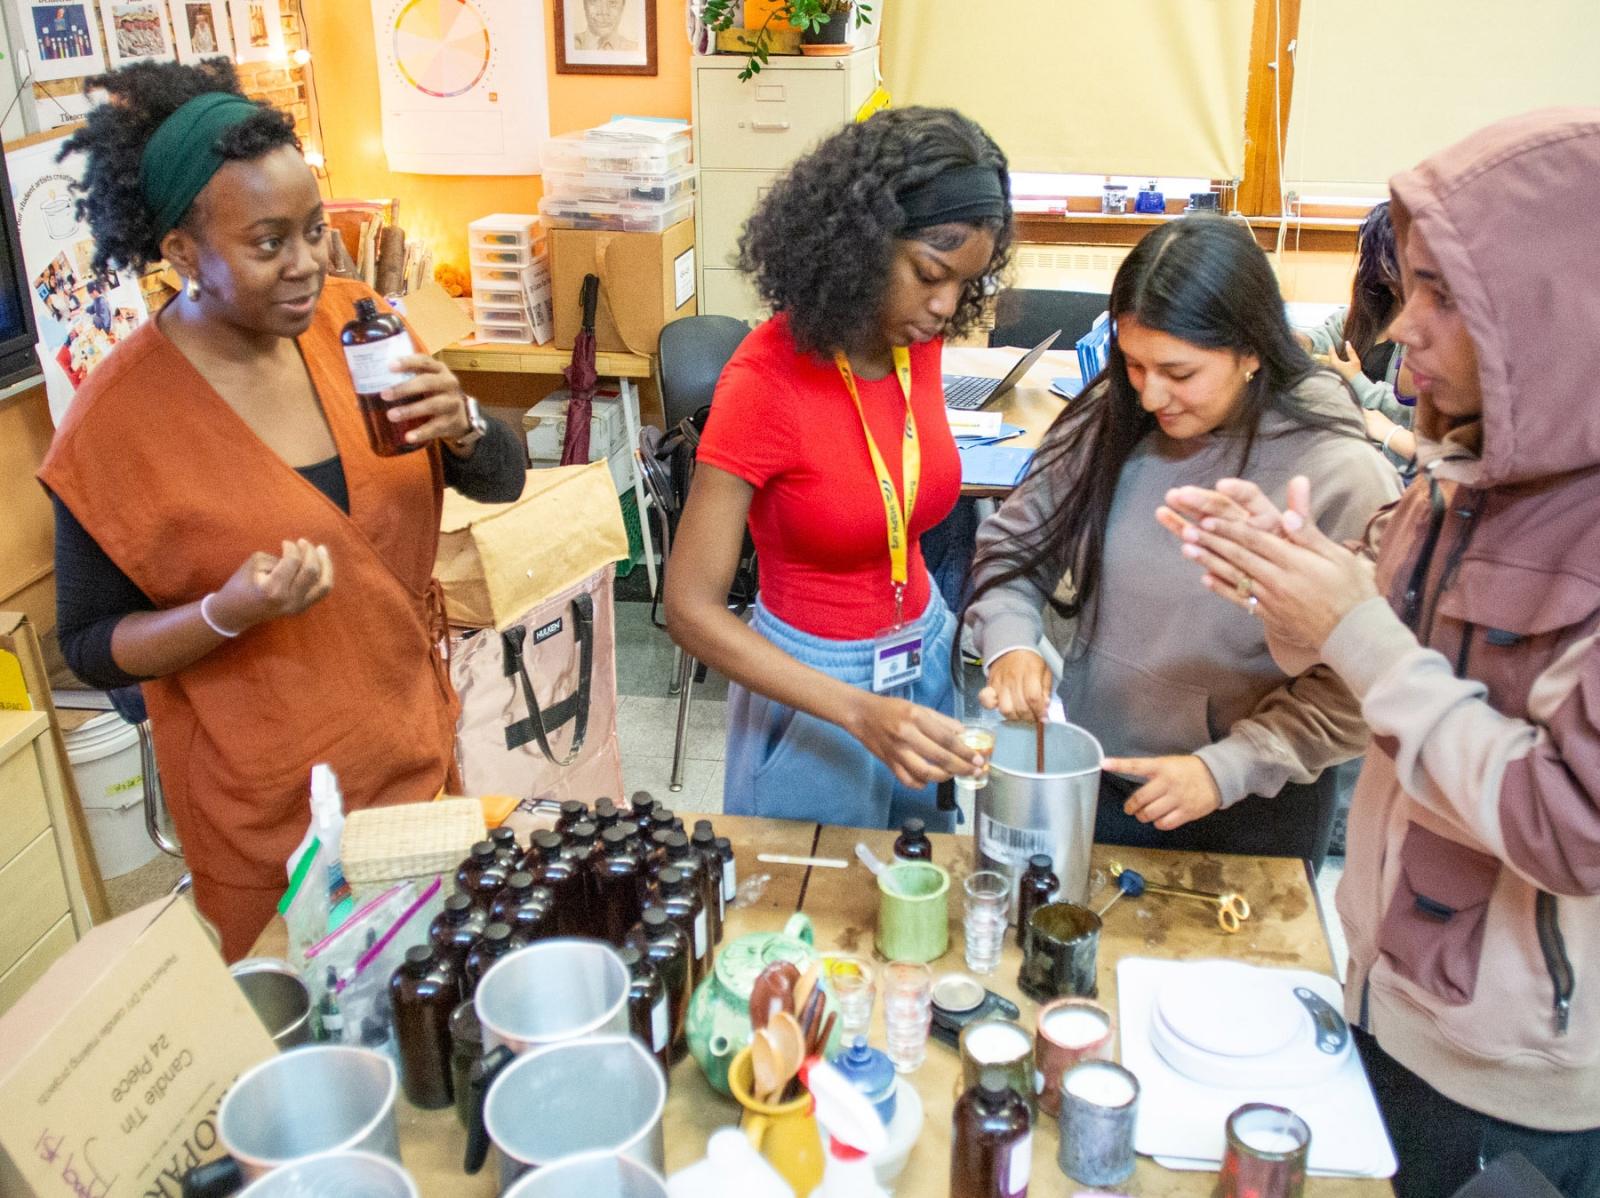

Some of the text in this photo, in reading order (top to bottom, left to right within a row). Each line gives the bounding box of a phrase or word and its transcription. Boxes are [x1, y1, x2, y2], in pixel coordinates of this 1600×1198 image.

[111, 1034, 170, 1103] 24 Piece
[144, 1048, 194, 1105] Candle
[119, 1106, 149, 1135] Tin
